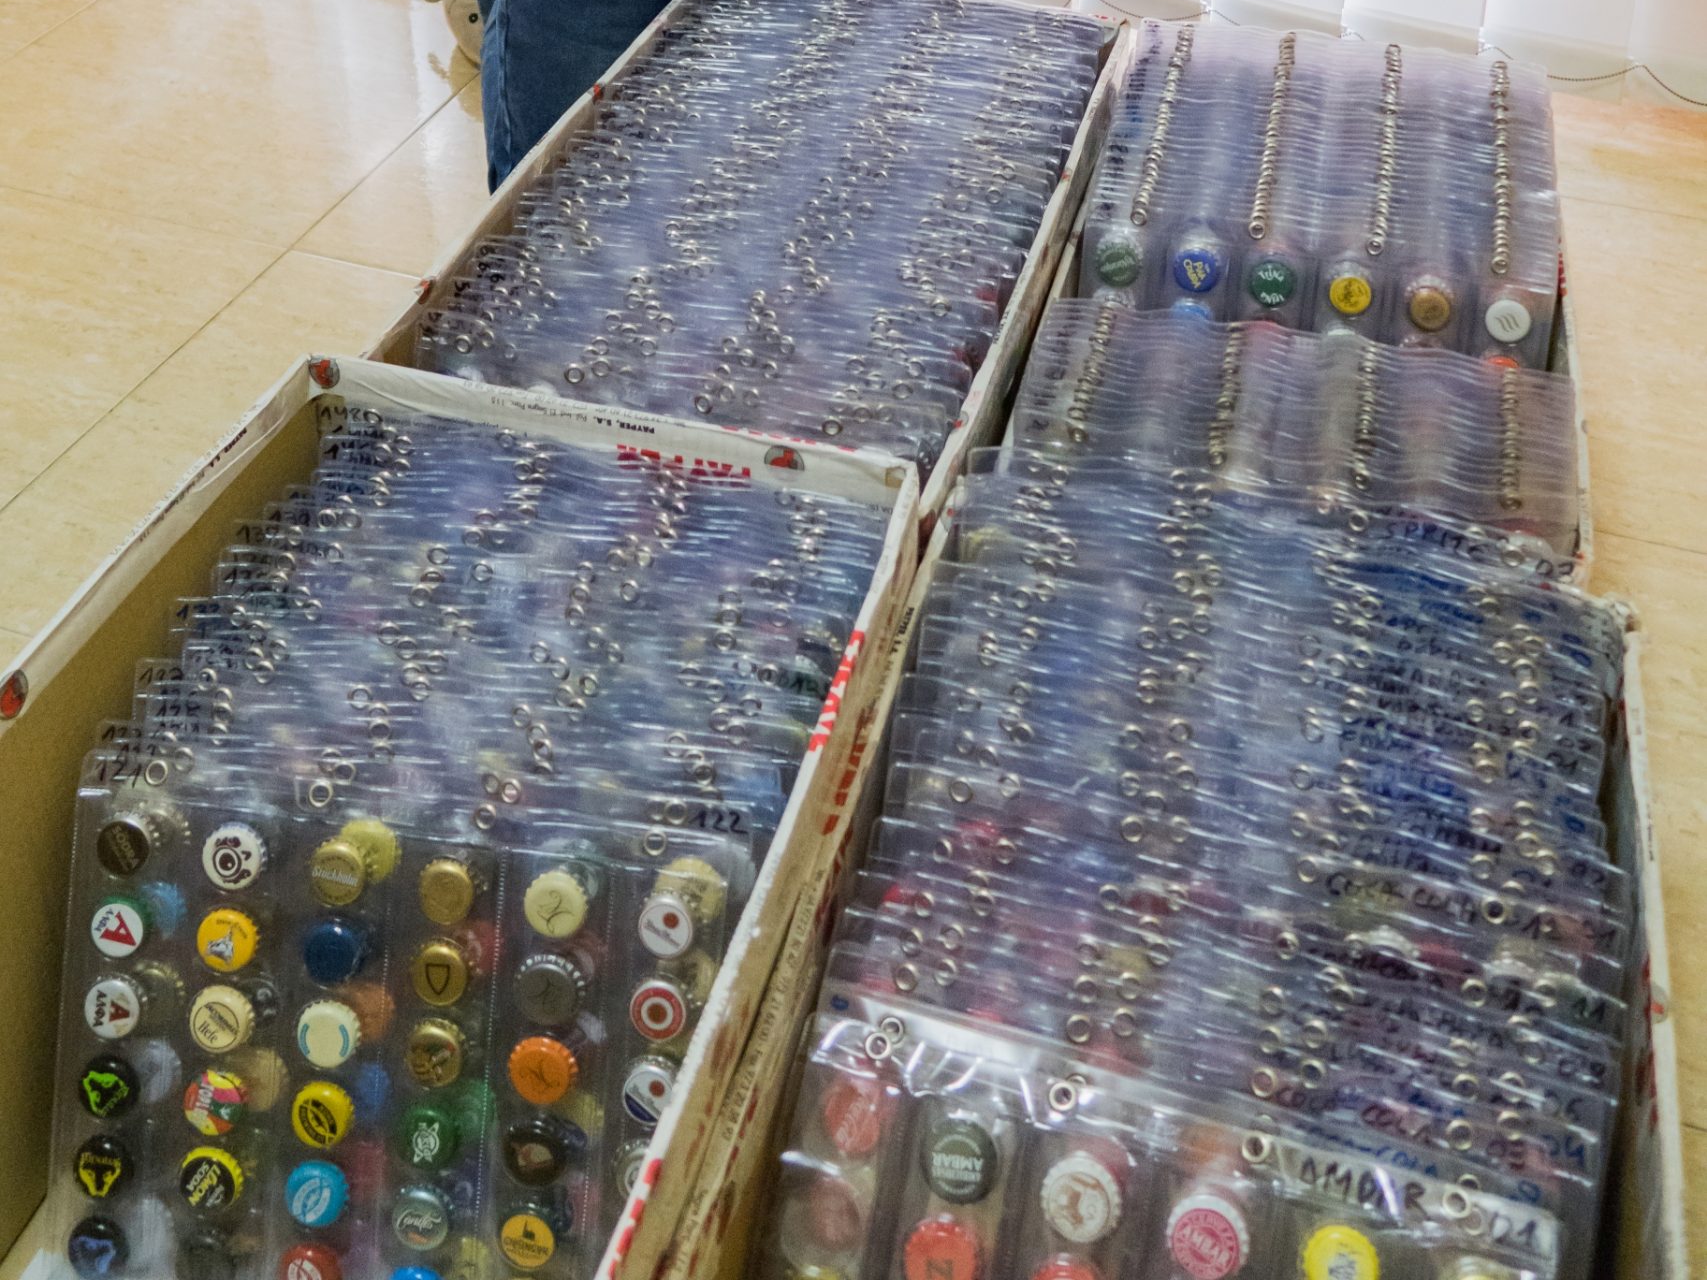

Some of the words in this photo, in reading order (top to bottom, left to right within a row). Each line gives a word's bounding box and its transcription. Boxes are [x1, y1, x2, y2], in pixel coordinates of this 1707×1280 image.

[592, 416, 612, 426] S.A.
[615, 419, 656, 434] PAYPER,
[689, 806, 749, 835] 122
[932, 1151, 984, 1169] AMBAR
[1181, 1229, 1231, 1265] AMBAR
